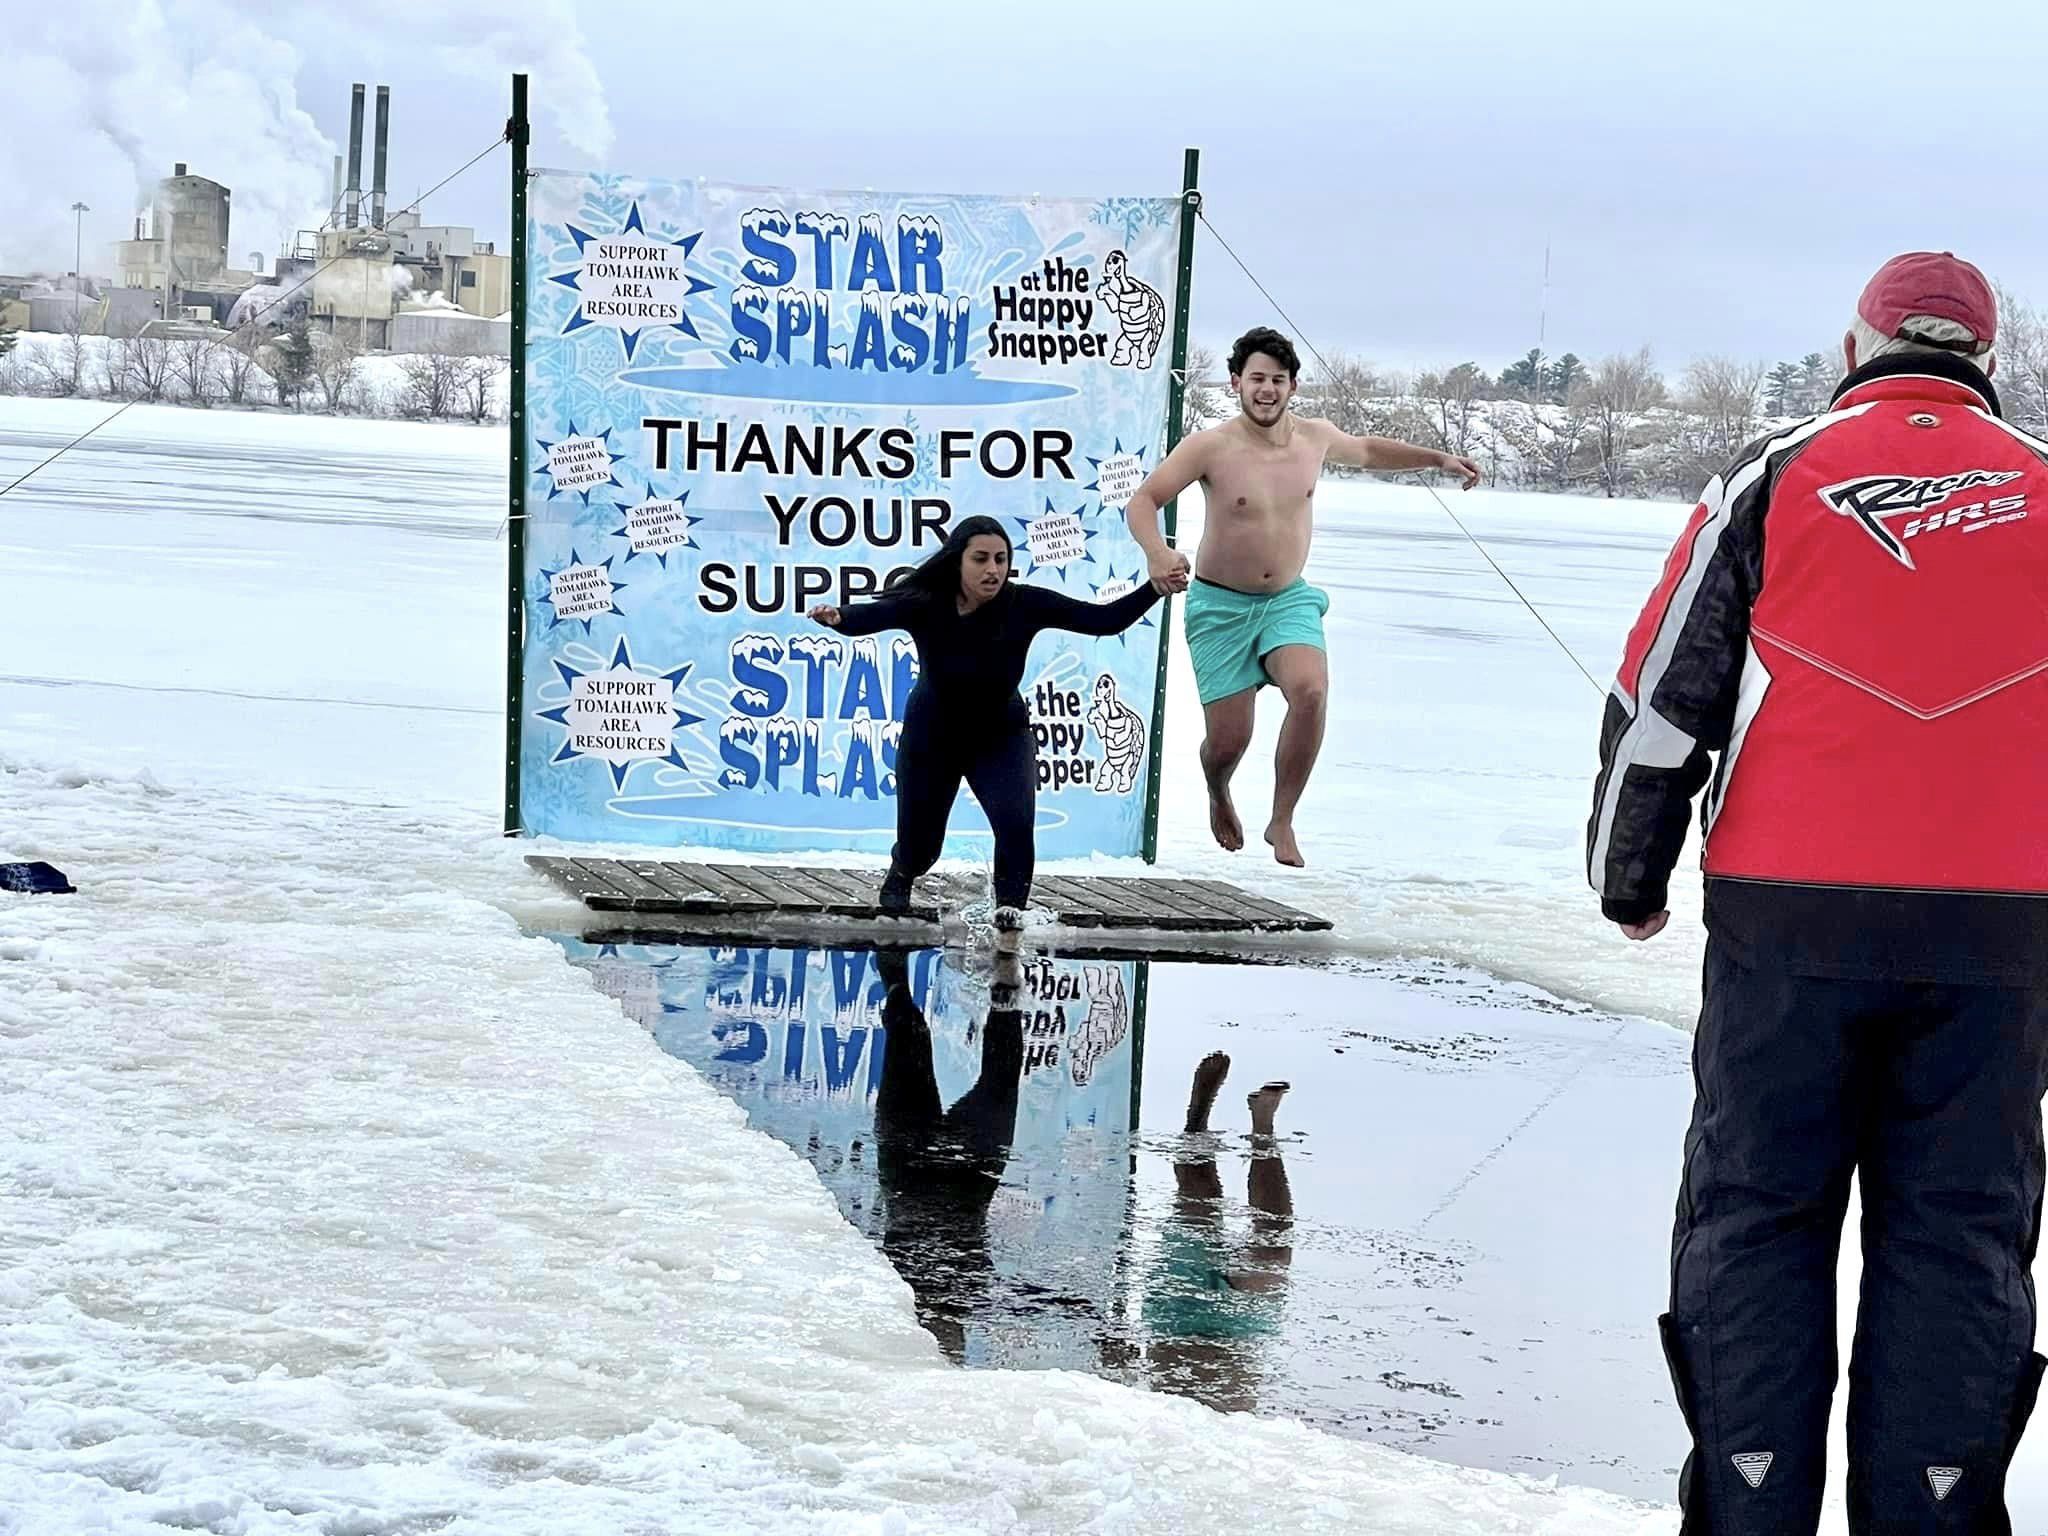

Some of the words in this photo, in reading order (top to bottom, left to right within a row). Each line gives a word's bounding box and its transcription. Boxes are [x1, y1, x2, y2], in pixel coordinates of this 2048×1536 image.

[599, 244, 669, 262] SUPPORT
[740, 207, 944, 294] STAR
[586, 263, 680, 282] TOMAHAWK
[1020, 272, 1041, 293] at
[1043, 257, 1090, 293] the
[611, 284, 653, 299] AREA
[586, 300, 678, 319] RESOURCES
[992, 286, 1093, 331] Happy
[729, 284, 971, 375] SPLASH
[988, 322, 1108, 365] Snapper
[557, 441, 596, 454] SUPPORT
[643, 419, 915, 480] THANKS
[940, 430, 1076, 480] FOR
[552, 450, 606, 466] TOMAHAWK
[569, 463, 593, 475] AREA
[556, 471, 608, 488] RESOURCES
[1104, 489, 1136, 503] RESOURC
[634, 503, 673, 517] SUPPORT
[1902, 494, 2027, 540] HRS
[630, 513, 683, 529] TOMAHAWK
[765, 495, 952, 548] YOUR
[1034, 518, 1071, 532] SUPPORT
[647, 526, 671, 537] AREA
[1031, 527, 1080, 543] TOMAHAWK
[634, 534, 686, 550] RESOURCES
[1046, 540, 1069, 550] AREA
[1035, 547, 1083, 563] RESOURCES
[559, 569, 598, 583] SUPPORT
[554, 579, 608, 596] TOMAHAWK
[571, 592, 595, 602] AREA
[558, 600, 610, 616] RESOURCES
[586, 680, 656, 696] SUPPORT
[575, 698, 668, 715] TOMAHAWK
[1036, 681, 1081, 717] the
[600, 718, 641, 733] AREA
[575, 735, 666, 752] RESOURCES
[1031, 723, 1083, 755] ppy
[718, 716, 903, 800] SPLA
[1035, 758, 1095, 791] pper
